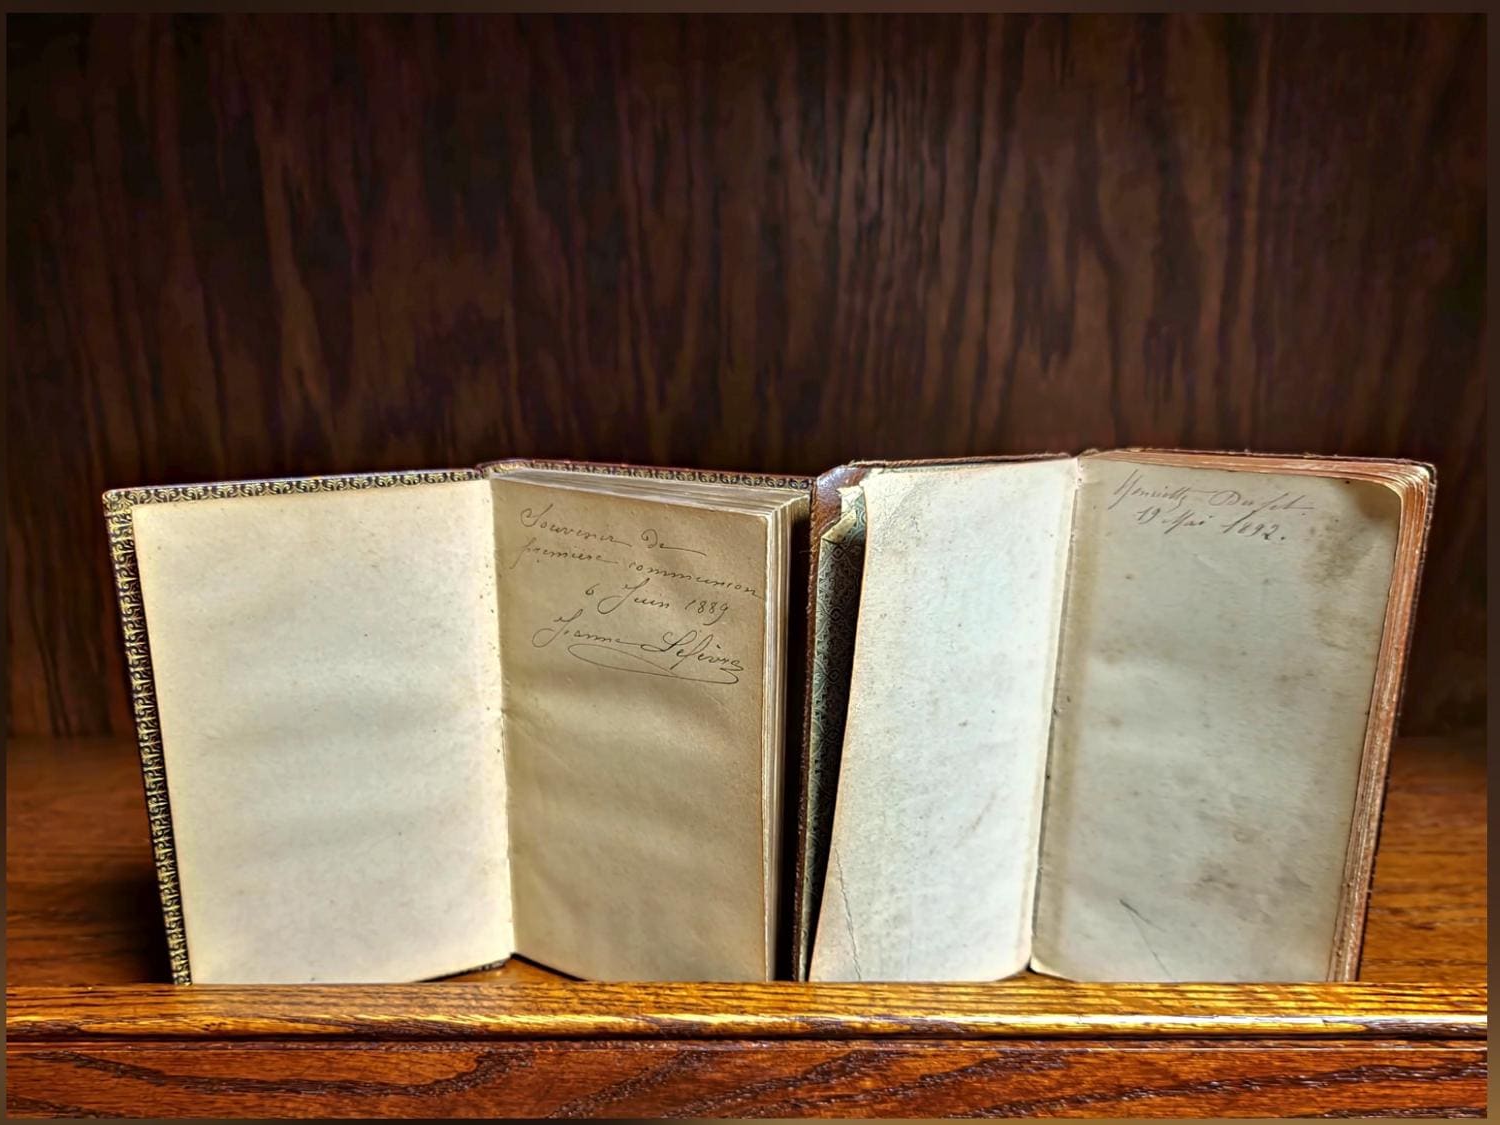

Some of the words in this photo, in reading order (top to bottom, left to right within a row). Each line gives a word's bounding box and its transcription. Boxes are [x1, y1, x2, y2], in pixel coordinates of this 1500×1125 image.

[520, 504, 632, 548] Souvenir
[628, 560, 763, 599] communion
[585, 584, 600, 596] 6
[686, 600, 728, 626] 1889
